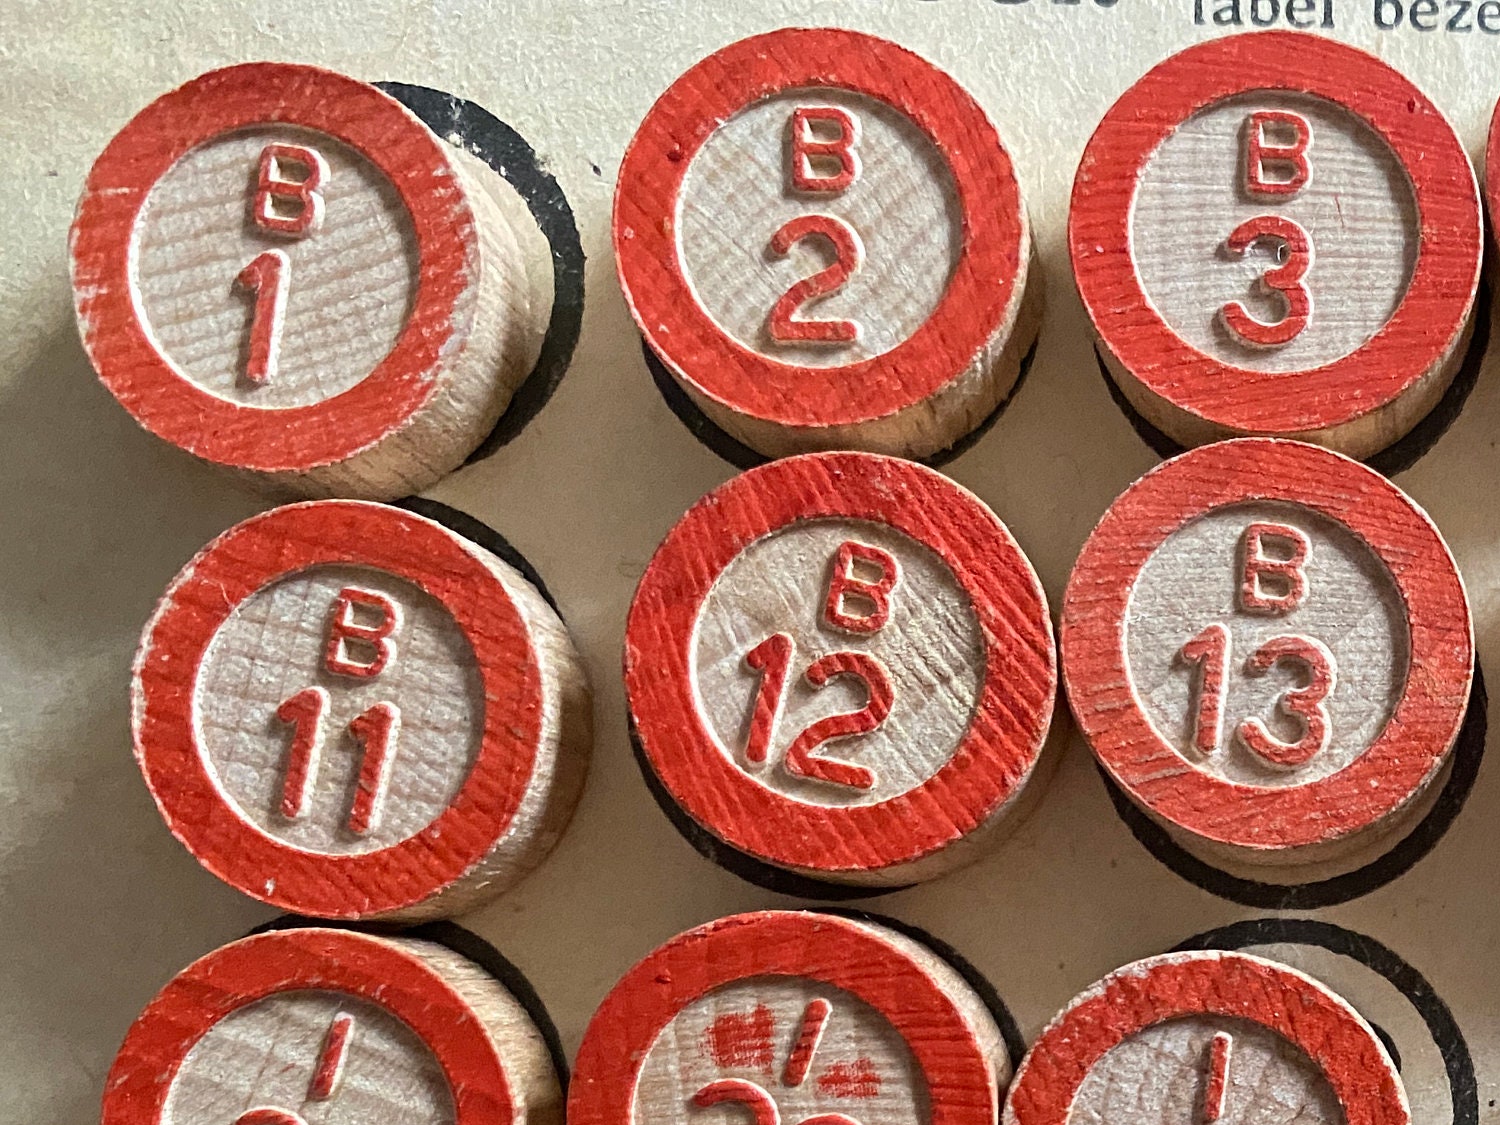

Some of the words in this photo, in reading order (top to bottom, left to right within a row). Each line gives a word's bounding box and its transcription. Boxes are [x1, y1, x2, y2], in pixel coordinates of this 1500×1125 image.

[255, 143, 330, 237] B
[792, 106, 860, 194] B
[1247, 109, 1313, 195] B
[234, 248, 290, 387] 1
[769, 212, 865, 345] 2
[1222, 214, 1314, 347] 3
[823, 539, 900, 636] B
[1240, 521, 1313, 614] B
[326, 586, 402, 679] B
[744, 631, 893, 793] 12
[1178, 622, 1338, 768] 13
[275, 685, 400, 835] 11
